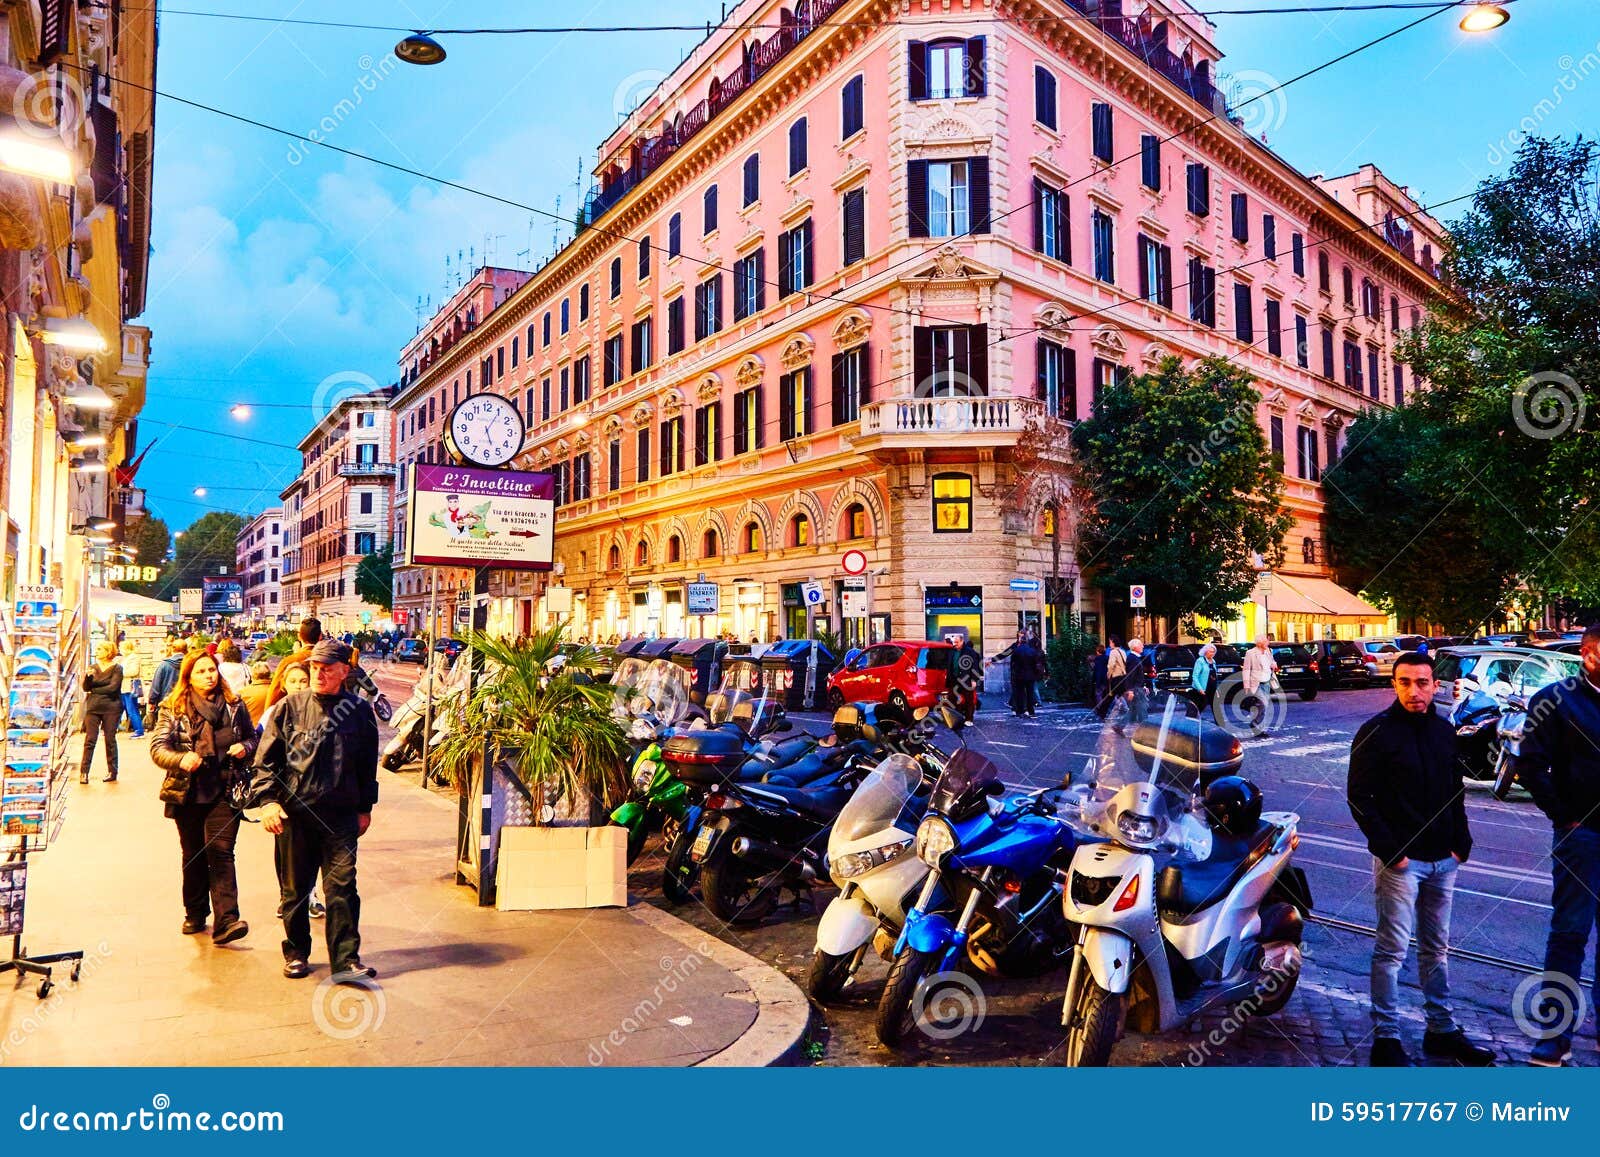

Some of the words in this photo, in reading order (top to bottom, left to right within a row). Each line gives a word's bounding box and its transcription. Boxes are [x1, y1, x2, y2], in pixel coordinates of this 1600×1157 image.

[473, 406, 480, 414] 11
[483, 403, 492, 412] 12
[497, 408, 500, 416] 1
[464, 412, 473, 421] 10
[504, 417, 510, 425] 2
[461, 424, 467, 432] 9
[507, 429, 513, 437] 3
[464, 436, 470, 444] 8
[483, 450, 490, 458] 6
[495, 448, 501, 456] 5
